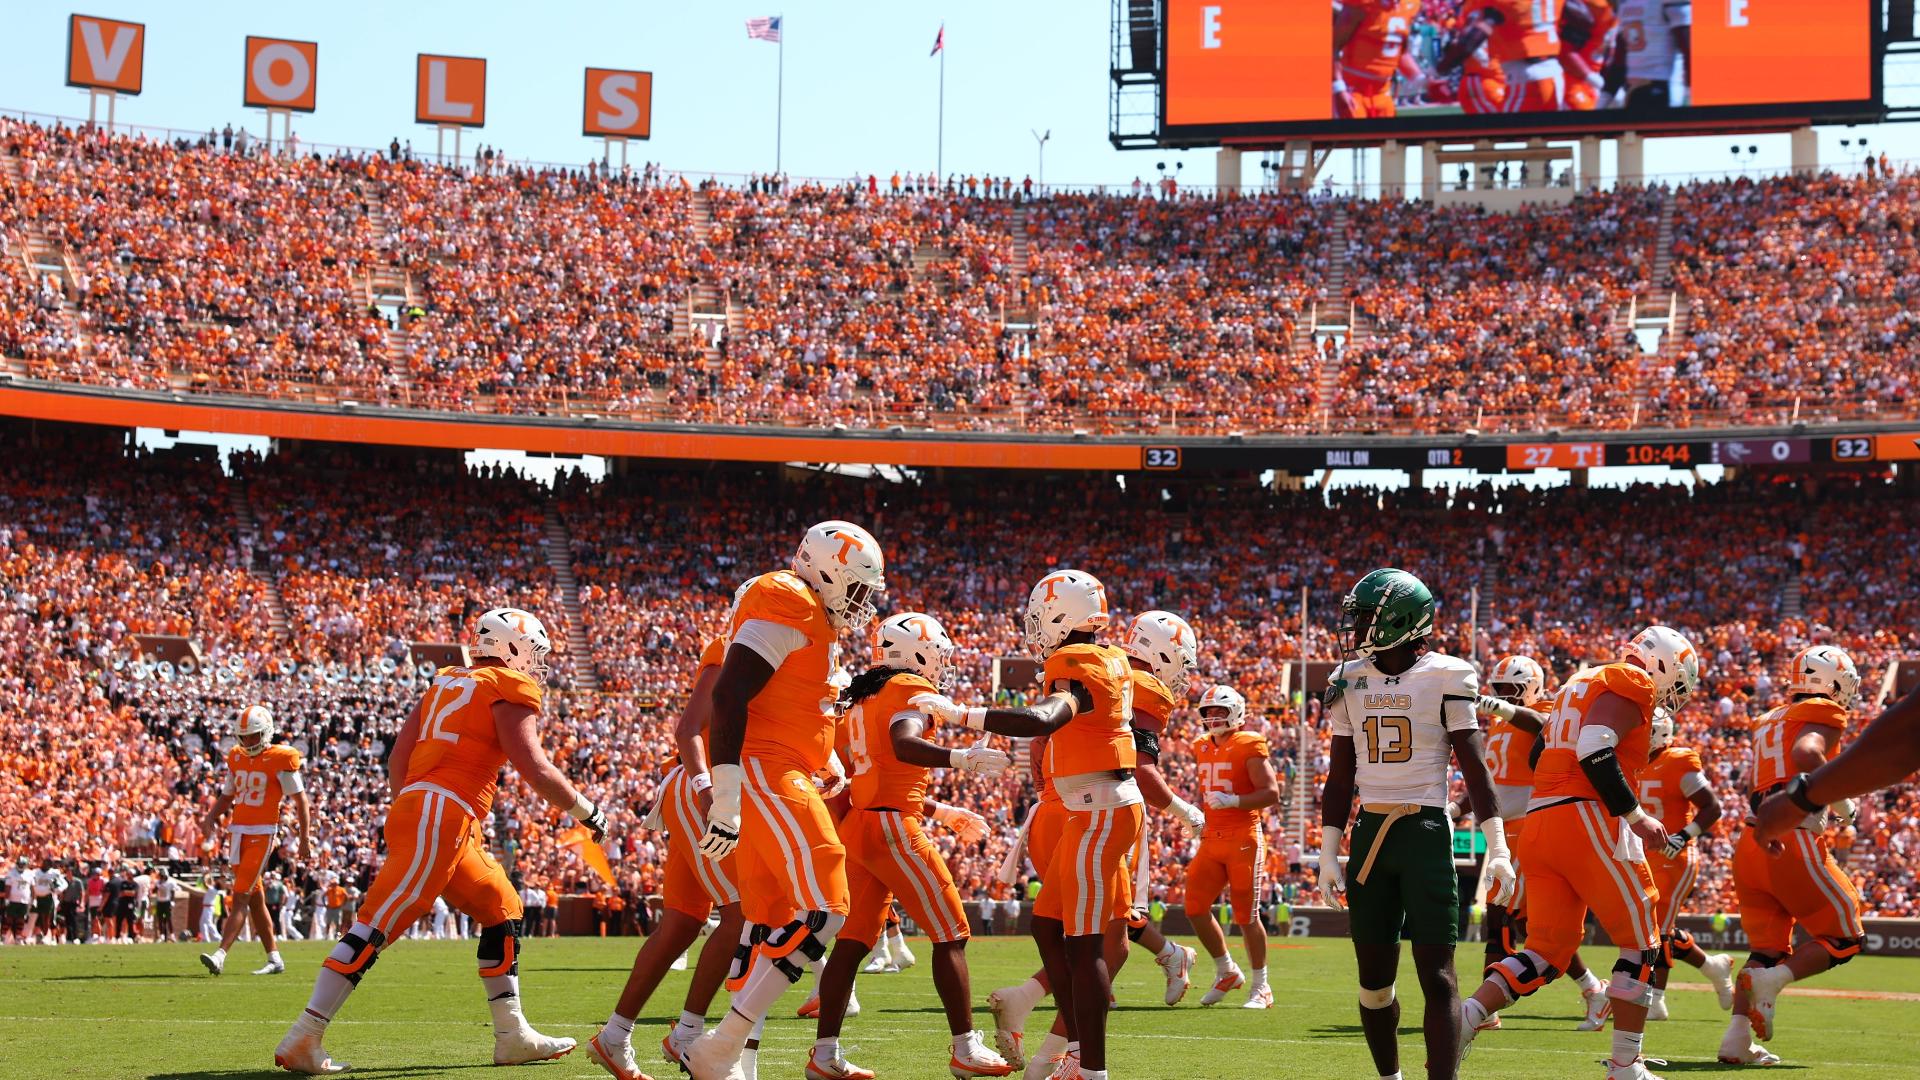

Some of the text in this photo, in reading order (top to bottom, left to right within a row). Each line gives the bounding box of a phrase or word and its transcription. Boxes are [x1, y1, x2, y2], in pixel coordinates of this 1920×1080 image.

[1147, 449, 1177, 466] 32
[1326, 451, 1369, 465] BALL ON
[1427, 449, 1462, 466] QTR 2
[1523, 446, 1592, 467] 27 T
[1625, 445, 1690, 464] 10:44
[1771, 441, 1790, 461] 0
[1837, 439, 1869, 458] 32
[833, 532, 864, 565] T
[1039, 576, 1065, 603] T
[1364, 694, 1411, 710] UAB
[1362, 715, 1412, 763] 13
